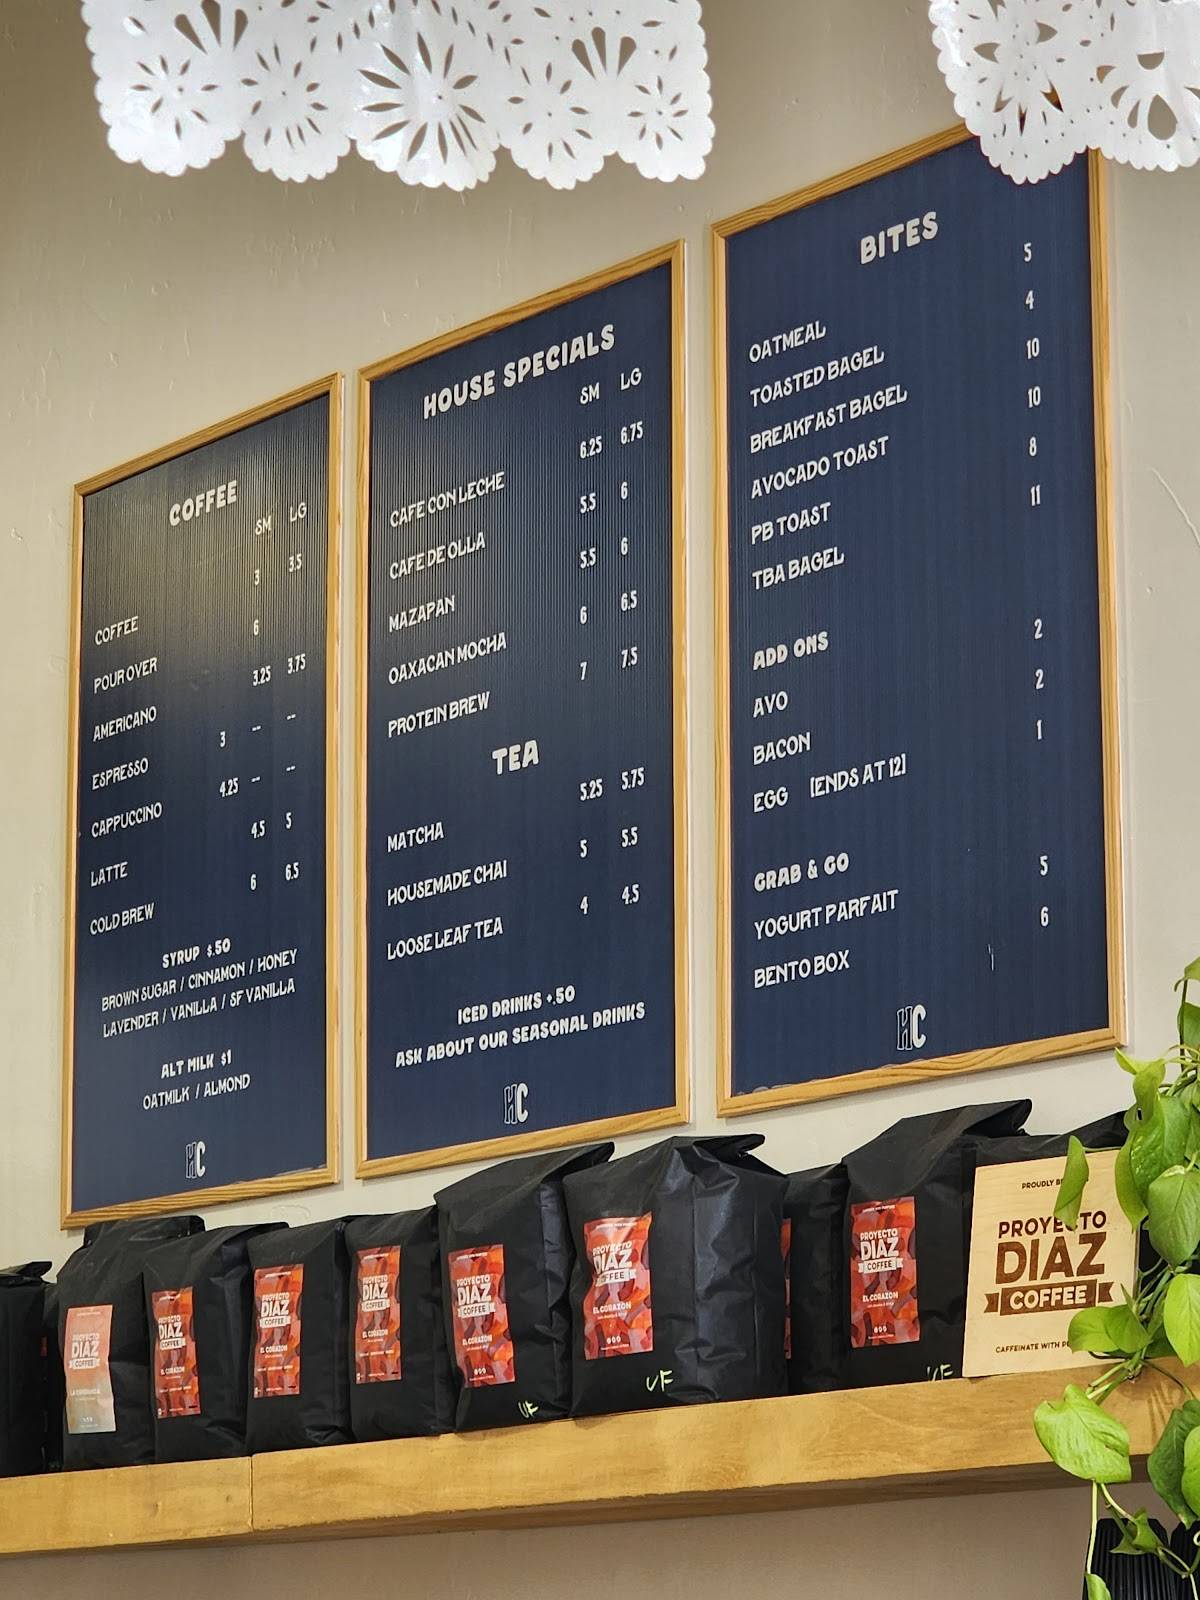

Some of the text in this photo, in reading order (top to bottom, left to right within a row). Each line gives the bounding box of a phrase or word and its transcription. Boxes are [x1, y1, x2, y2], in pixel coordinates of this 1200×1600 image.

[860, 210, 939, 265] BITES
[748, 242, 1032, 364] OATMEAL 5
[423, 324, 615, 420] HOUSE SPECIALS
[750, 289, 1035, 408] TOASTED BAGEL 4
[580, 367, 642, 405] SM LG
[750, 338, 1040, 455] BREAKFAST BAGEL 10
[750, 386, 1041, 500] AVOCADO TOAST 10
[169, 480, 238, 527] COFFEE
[390, 421, 644, 528] CAFE CON LECHE 6.25 6.75
[751, 437, 1037, 546] PB TOAST 8
[255, 502, 307, 535] SM LG
[390, 481, 628, 580] CAFE DE OLLA 5.5 6
[751, 485, 1041, 591] TBA BAGEL 11
[95, 553, 302, 645] COFFEE 3 3.5
[389, 537, 628, 633] MAZAPAN 5.5 6
[94, 619, 259, 694] POUR OVER 6
[388, 590, 638, 685] OAXACAN MOCHA 6 6.5
[752, 631, 829, 672] ADD ONS
[752, 618, 1043, 719] AVO 2
[93, 653, 306, 742] AMERICANO 3.25 3.75
[388, 646, 638, 739] PROTEIN BREW 7 7.5
[752, 668, 1044, 767] BACON 2
[92, 731, 226, 790] ESPRESSO 3
[491, 739, 540, 776] TEA
[753, 786, 789, 814] EGG
[862, 759, 886, 786] AT
[1036, 719, 1042, 740] 1
[91, 776, 239, 839] CAPPUCCINO 4.25
[387, 766, 645, 854] MATCHA 5.25 5.75
[90, 812, 292, 888] LATTE 4.5 5
[387, 826, 638, 907] HOUSEMADE CHAI 5 5.5
[754, 852, 850, 894] GRAB & GO
[89, 861, 299, 936] COLD BREW 6 6.5
[387, 883, 640, 962] LOOSE LEAF TEA 4 4.5
[754, 855, 1049, 941] YOGURT PARFAIT 5
[162, 945, 200, 968] SYRUP
[753, 907, 1049, 990] BENTO BOX 6
[101, 948, 298, 1013] BROWN SUGAR CINNAMON HONEY
[103, 978, 296, 1039] LAVENDER VANILLA SF VANILLA
[457, 1003, 488, 1026] ICED
[491, 991, 543, 1019] DRINKS
[161, 1049, 232, 1079] ALT MILK $1
[395, 1001, 645, 1068] ASK ABOUT OUR SEASONAL DRINKS
[142, 1073, 251, 1111] OATMILK ALMOND
[1021, 1180, 1054, 1189] PROUDLY
[860, 1228, 898, 1241] PROYECTO
[861, 1236, 899, 1261] DIAZ
[998, 1210, 1107, 1239] PROYETO
[593, 1250, 633, 1275] DIAZ
[867, 1260, 893, 1271] COFFEE
[995, 1231, 1107, 1285] DIAZ
[261, 1300, 290, 1318] DIAZ
[362, 1283, 389, 1301] DIAZ
[457, 1283, 492, 1306] DIAZ
[463, 1304, 487, 1316] COFFEE
[1009, 1285, 1088, 1310] COFFEE
[72, 1341, 100, 1359] DIAZ
[158, 1321, 184, 1340] DIAZ
[995, 1343, 1039, 1354] CAFFEINATE
[1040, 1341, 1061, 1349] WITH
